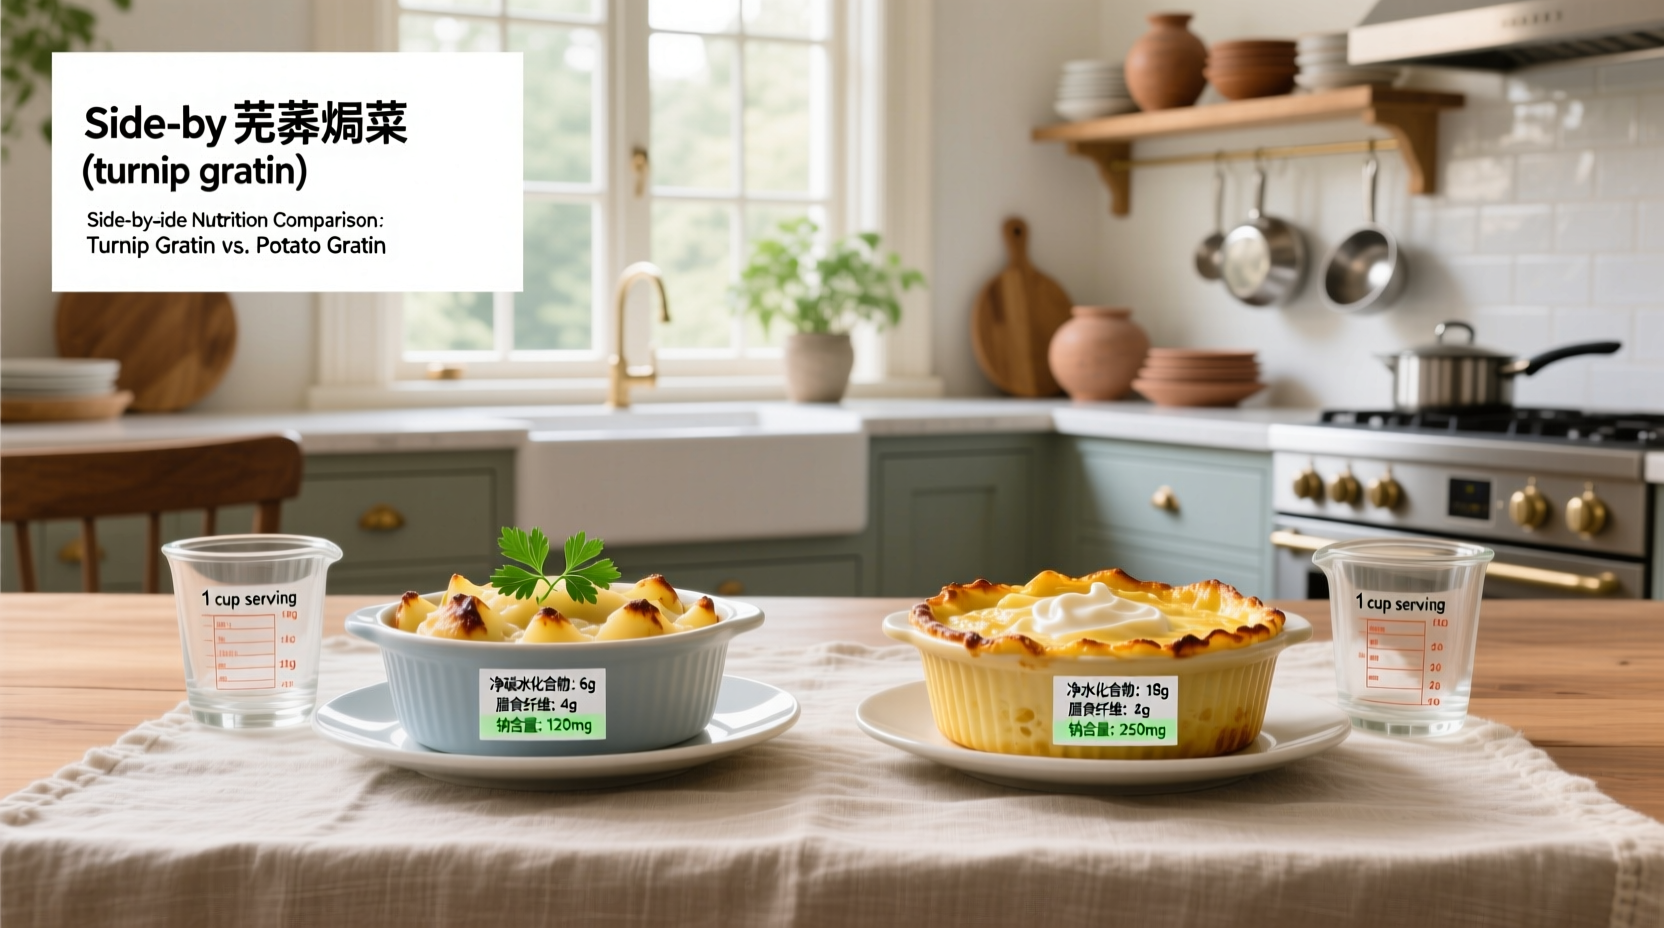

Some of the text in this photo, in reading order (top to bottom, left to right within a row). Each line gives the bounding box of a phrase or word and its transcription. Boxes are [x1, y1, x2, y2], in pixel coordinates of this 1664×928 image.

[200, 589, 298, 610] 1 cup serving
[1355, 592, 1446, 616] 1 cup serving
[579, 676, 596, 694] 6g
[560, 698, 578, 714] 4g
[1134, 703, 1151, 719] 2g
[546, 717, 593, 735] 120mg
[1119, 722, 1167, 741] 250mg
